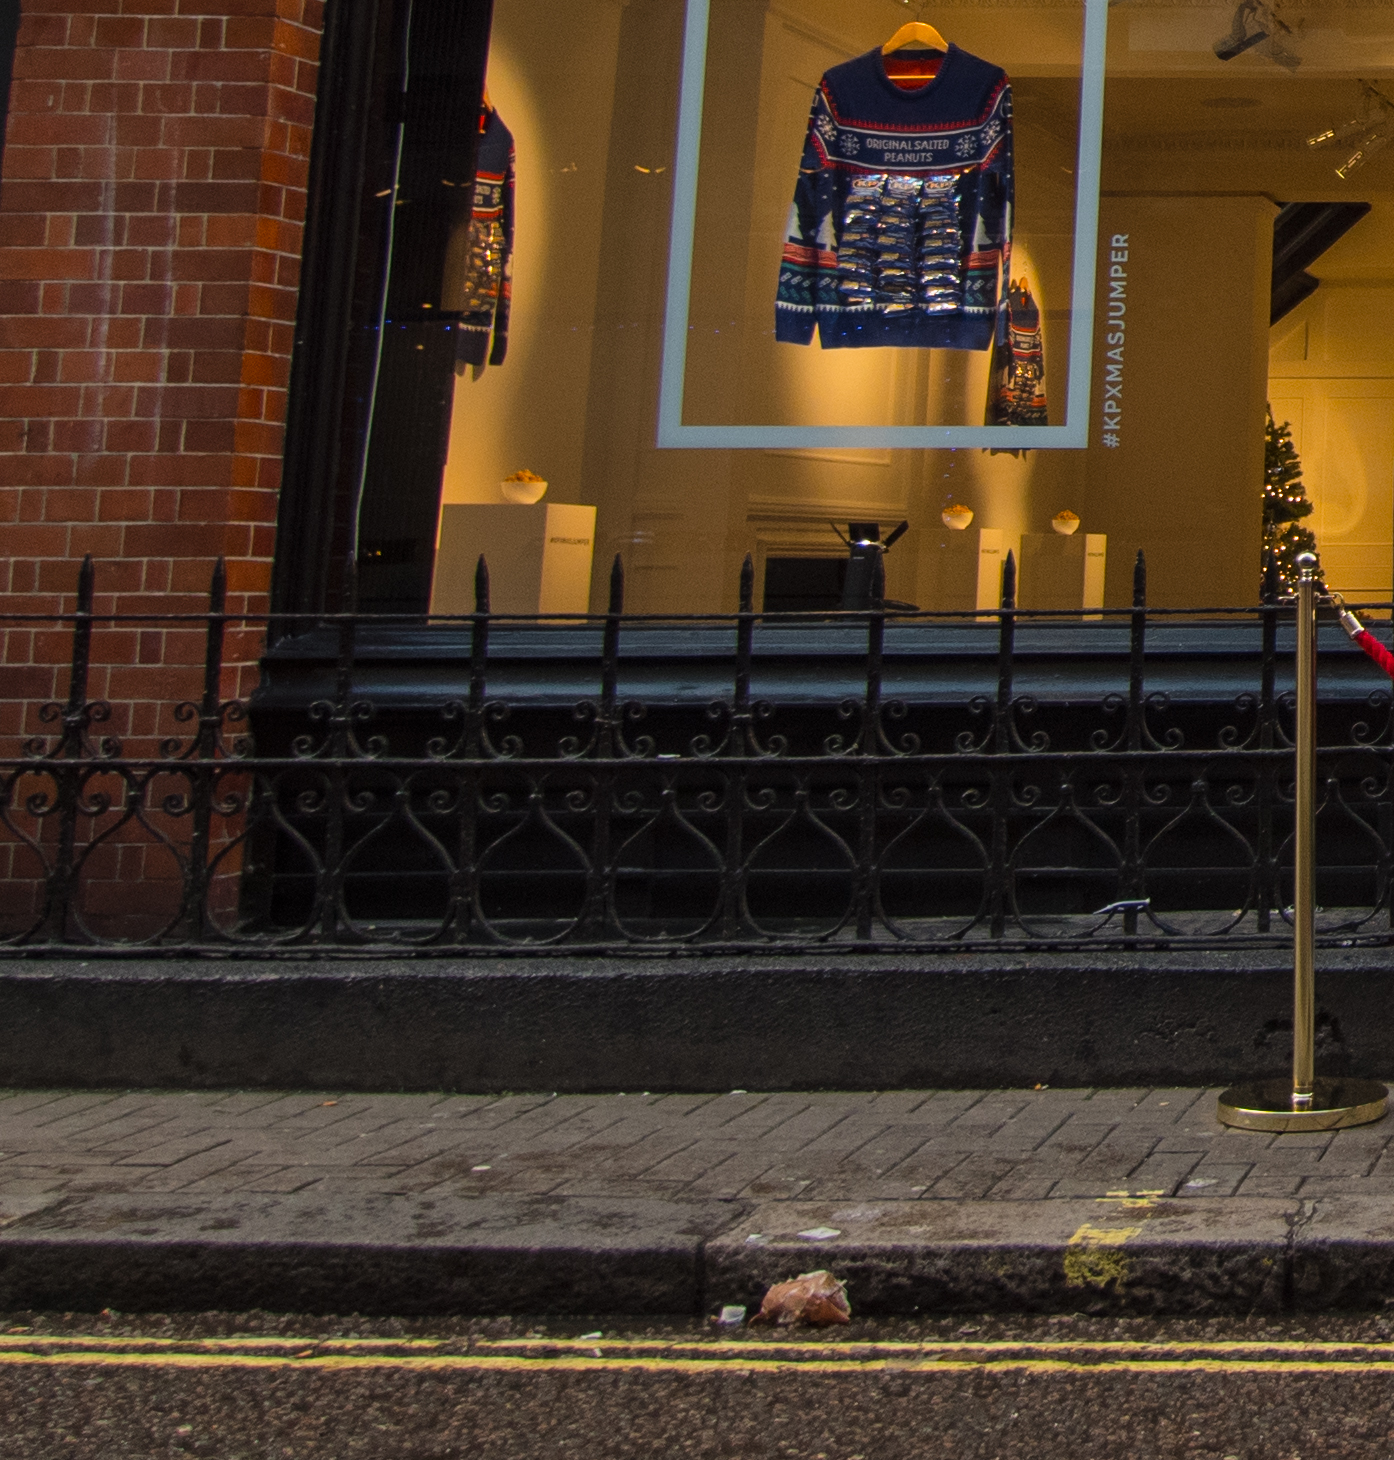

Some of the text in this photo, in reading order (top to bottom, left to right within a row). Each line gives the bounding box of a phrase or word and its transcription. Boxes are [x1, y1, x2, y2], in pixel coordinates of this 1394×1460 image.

[866, 138, 950, 150] ORIGINAL SALTED
[884, 152, 934, 162] PEANUTS
[1102, 233, 1129, 448] #KPXMASJUMPER
